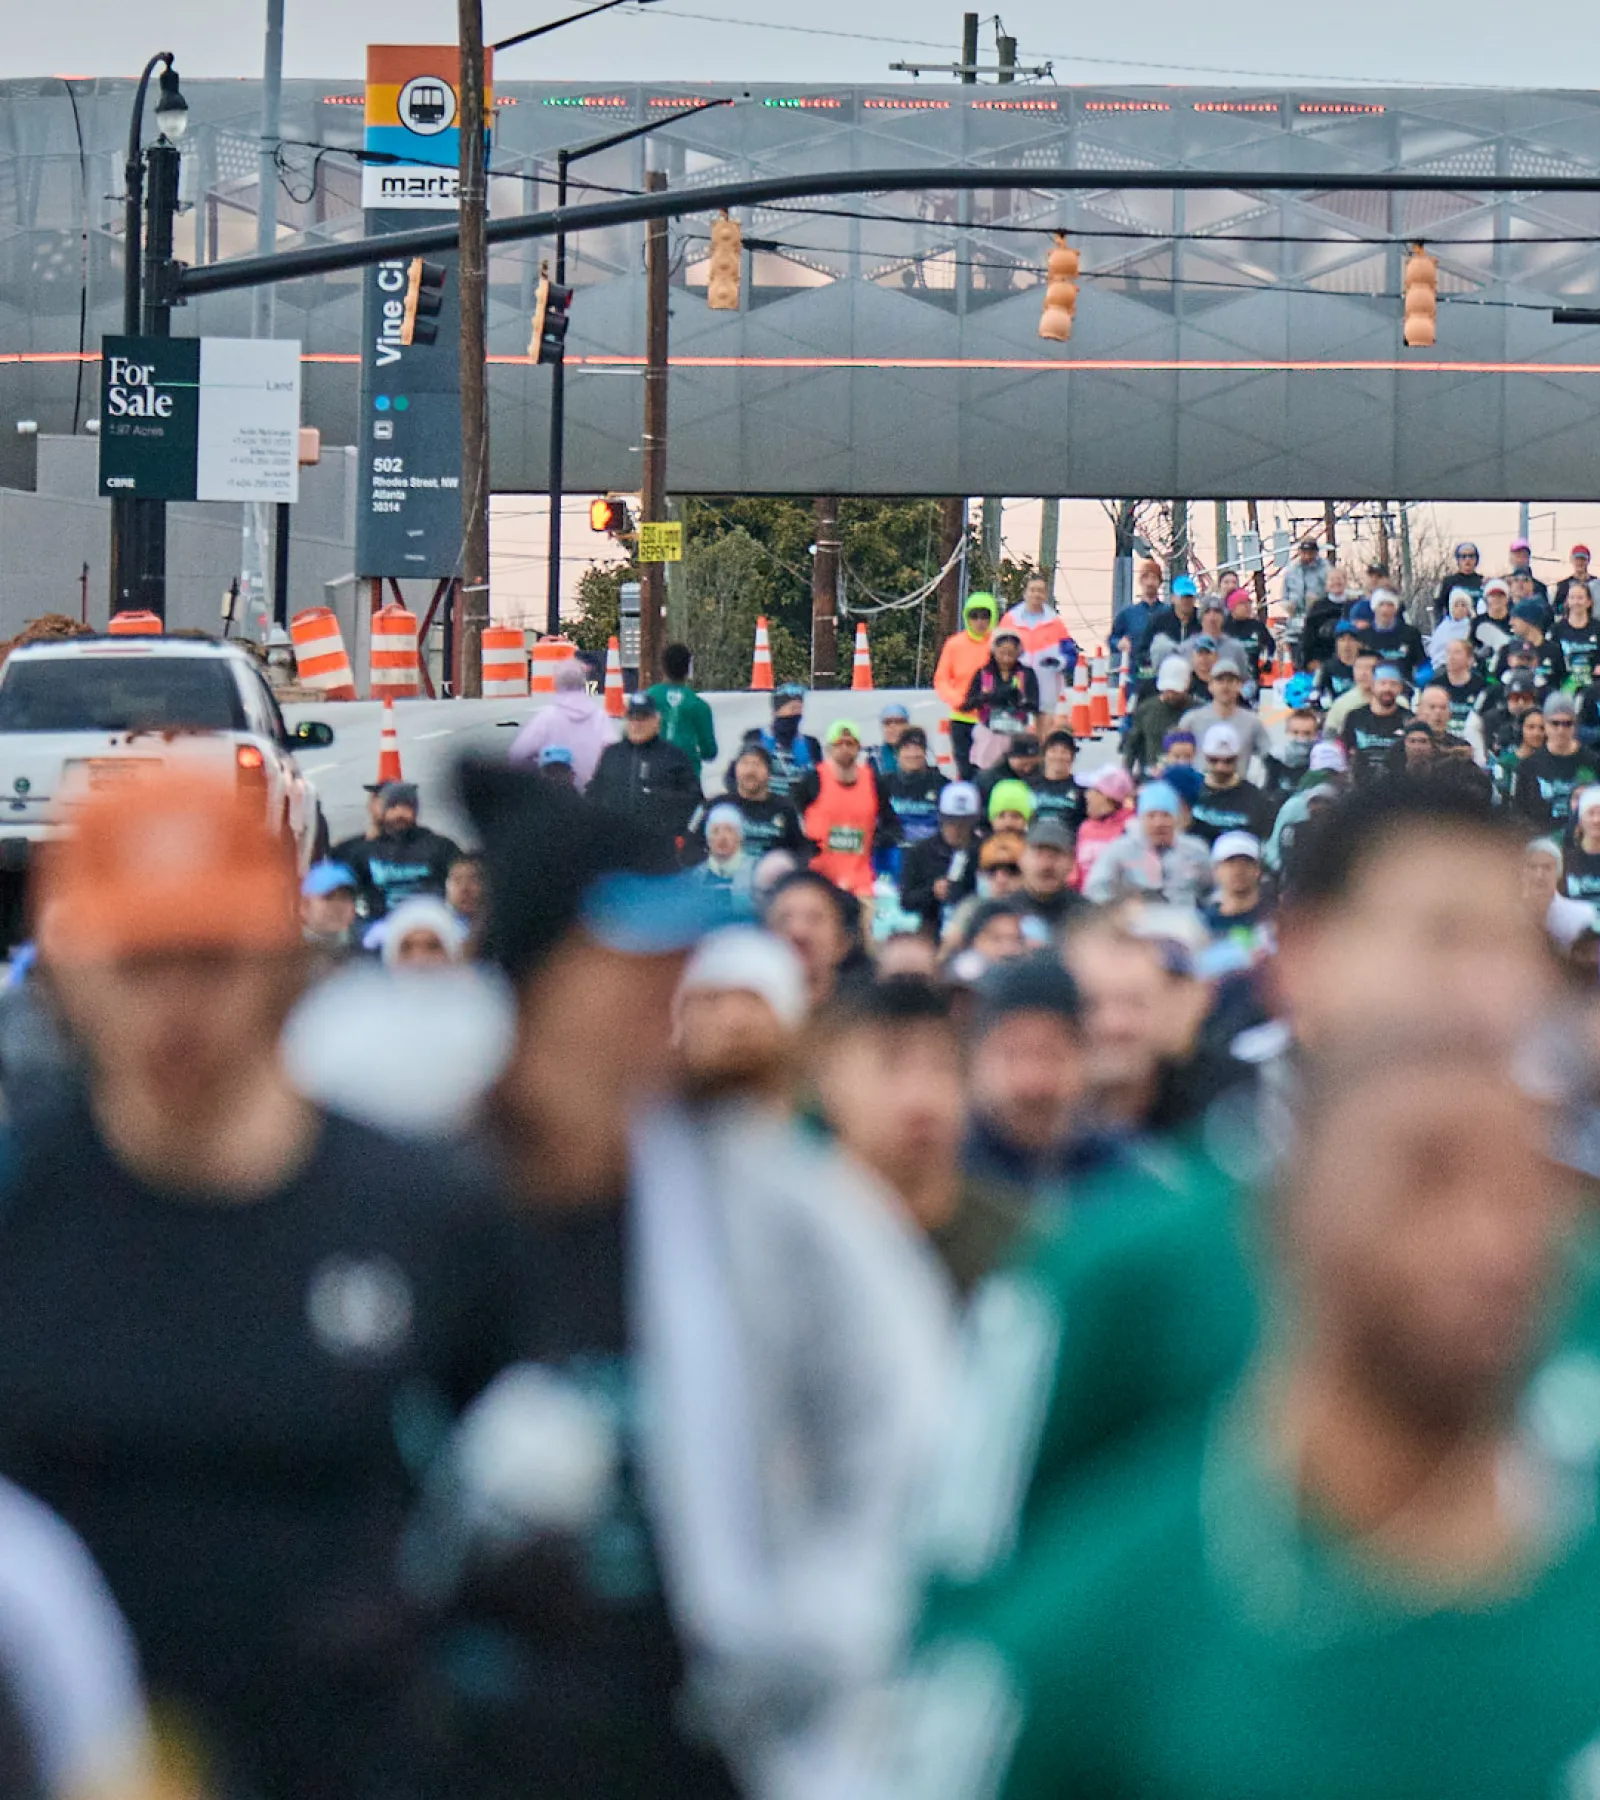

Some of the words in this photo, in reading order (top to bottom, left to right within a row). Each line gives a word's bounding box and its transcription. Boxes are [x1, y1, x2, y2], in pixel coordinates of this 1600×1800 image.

[376, 299, 404, 367] Vine
[108, 357, 155, 386] For
[266, 380, 294, 392] Land
[108, 386, 173, 417] Sale
[372, 457, 404, 473] 502
[372, 476, 408, 488] Rhodes
[440, 476, 460, 488] NW
[372, 489, 406, 500] Atlanta
